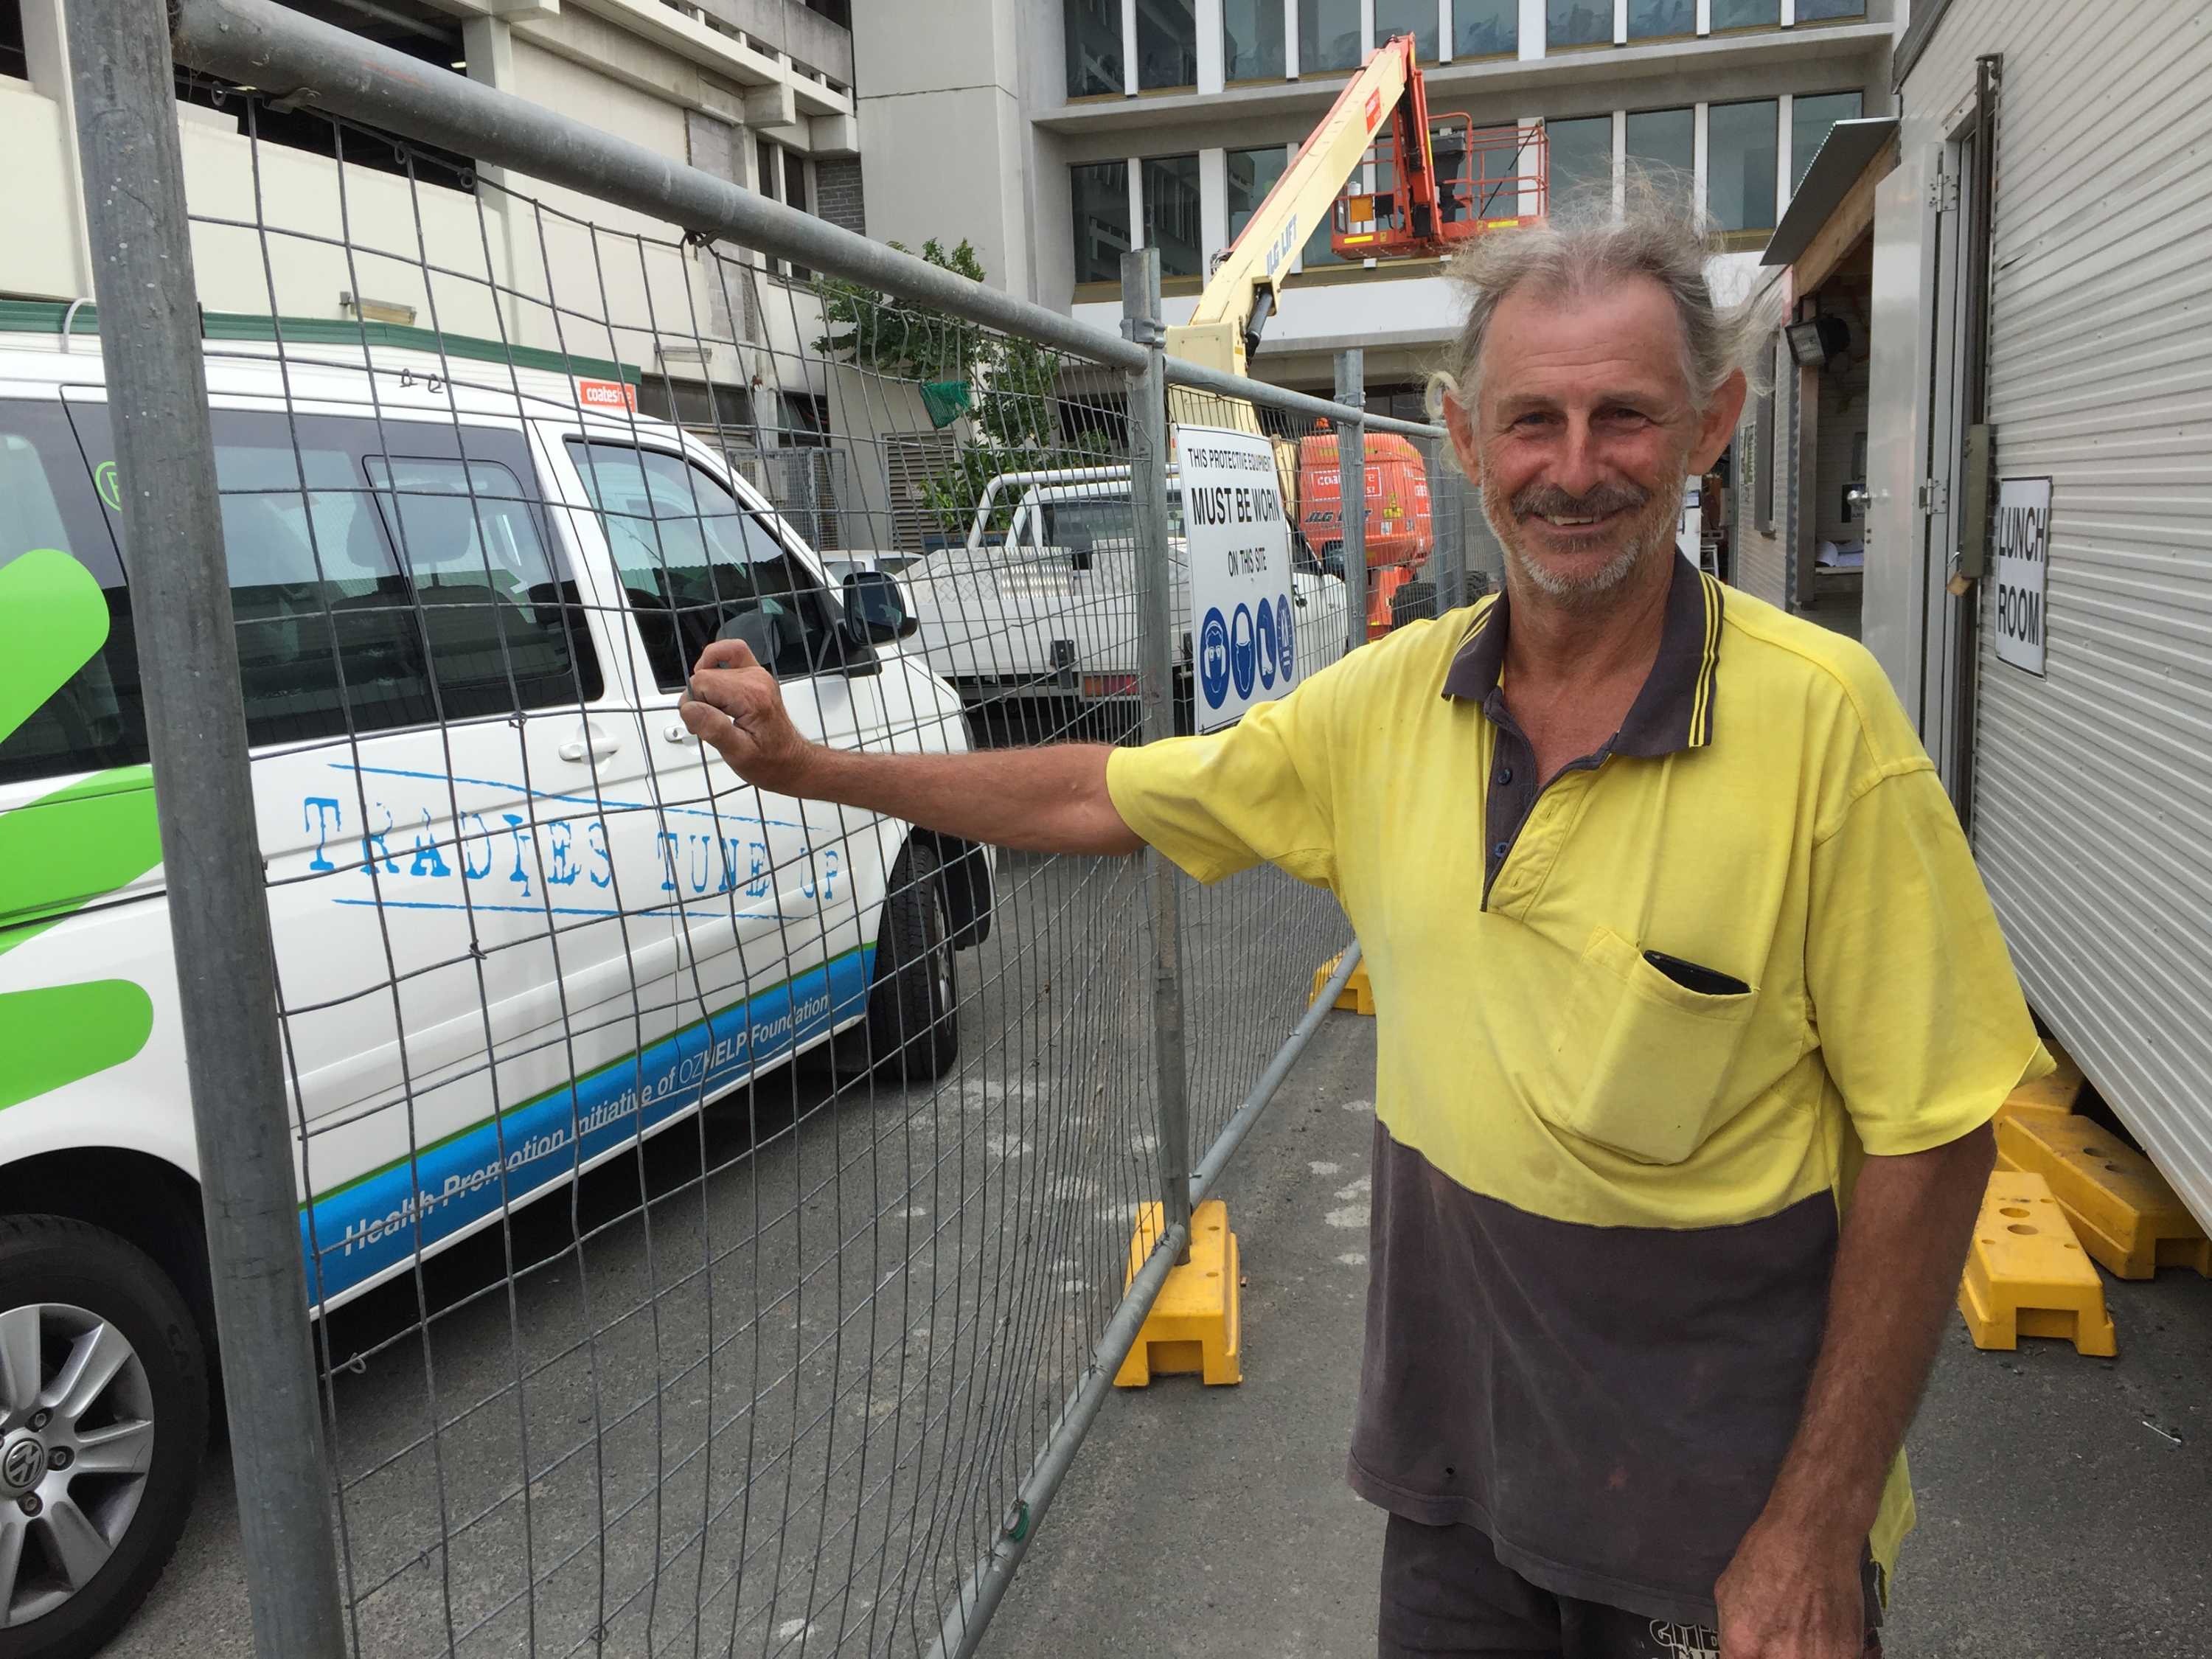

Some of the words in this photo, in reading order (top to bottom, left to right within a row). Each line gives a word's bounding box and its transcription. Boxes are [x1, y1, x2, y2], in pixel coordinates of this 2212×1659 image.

[1188, 448, 1208, 468] THIS
[1208, 449, 1248, 470] PROTECTIVE
[1191, 486, 1232, 525] MUST
[1236, 487, 1252, 523] BE
[1251, 487, 1280, 522] WORN
[1228, 550, 1239, 577] ON
[1239, 548, 1254, 574] THIS
[1255, 547, 1267, 573] SITE
[1999, 507, 2047, 563] LUNCH
[1998, 584, 2039, 646] ROOM
[304, 797, 611, 897] TRADIES
[657, 832, 771, 898] TUNE
[800, 847, 838, 900] UP
[345, 1190, 434, 1256] Health
[442, 1128, 564, 1207] Promotion
[571, 1085, 653, 1140] Initiative
[658, 1066, 678, 1096] of
